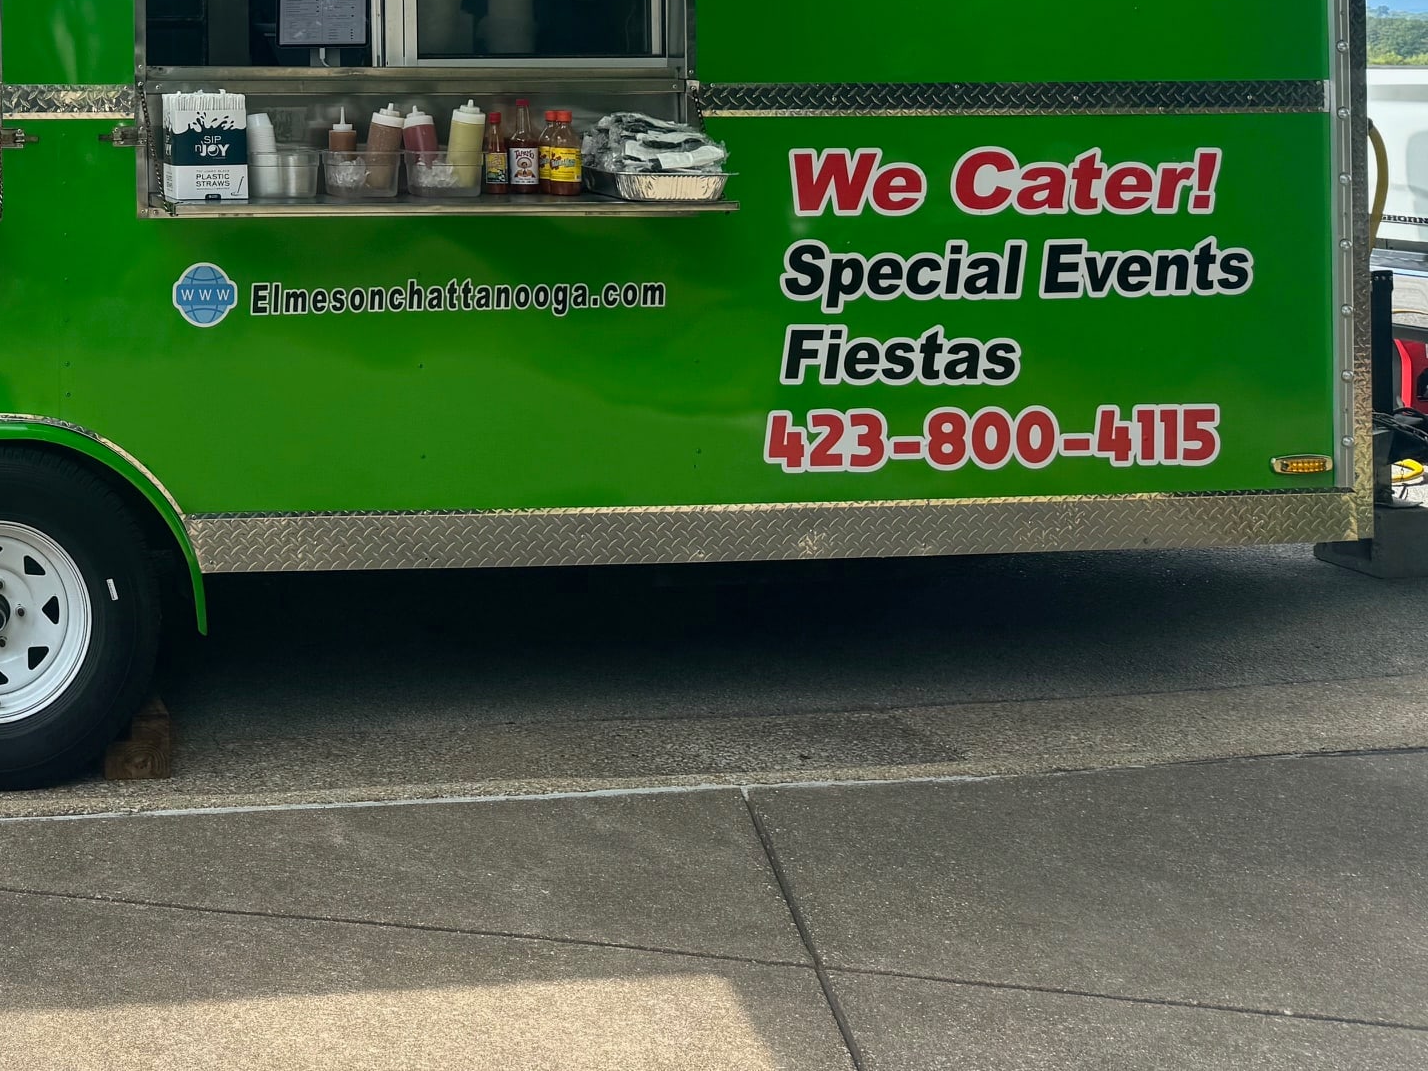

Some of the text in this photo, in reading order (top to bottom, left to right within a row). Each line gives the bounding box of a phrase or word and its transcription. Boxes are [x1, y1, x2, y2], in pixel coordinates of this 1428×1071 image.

[203, 135, 222, 144] SIP
[789, 145, 1222, 217] We Cater!
[250, 277, 667, 317] Elmesonchattanooga.com
[780, 236, 1253, 313] Special Events
[779, 324, 1021, 385] Fiestas
[763, 404, 1220, 472] 423-800-4115
